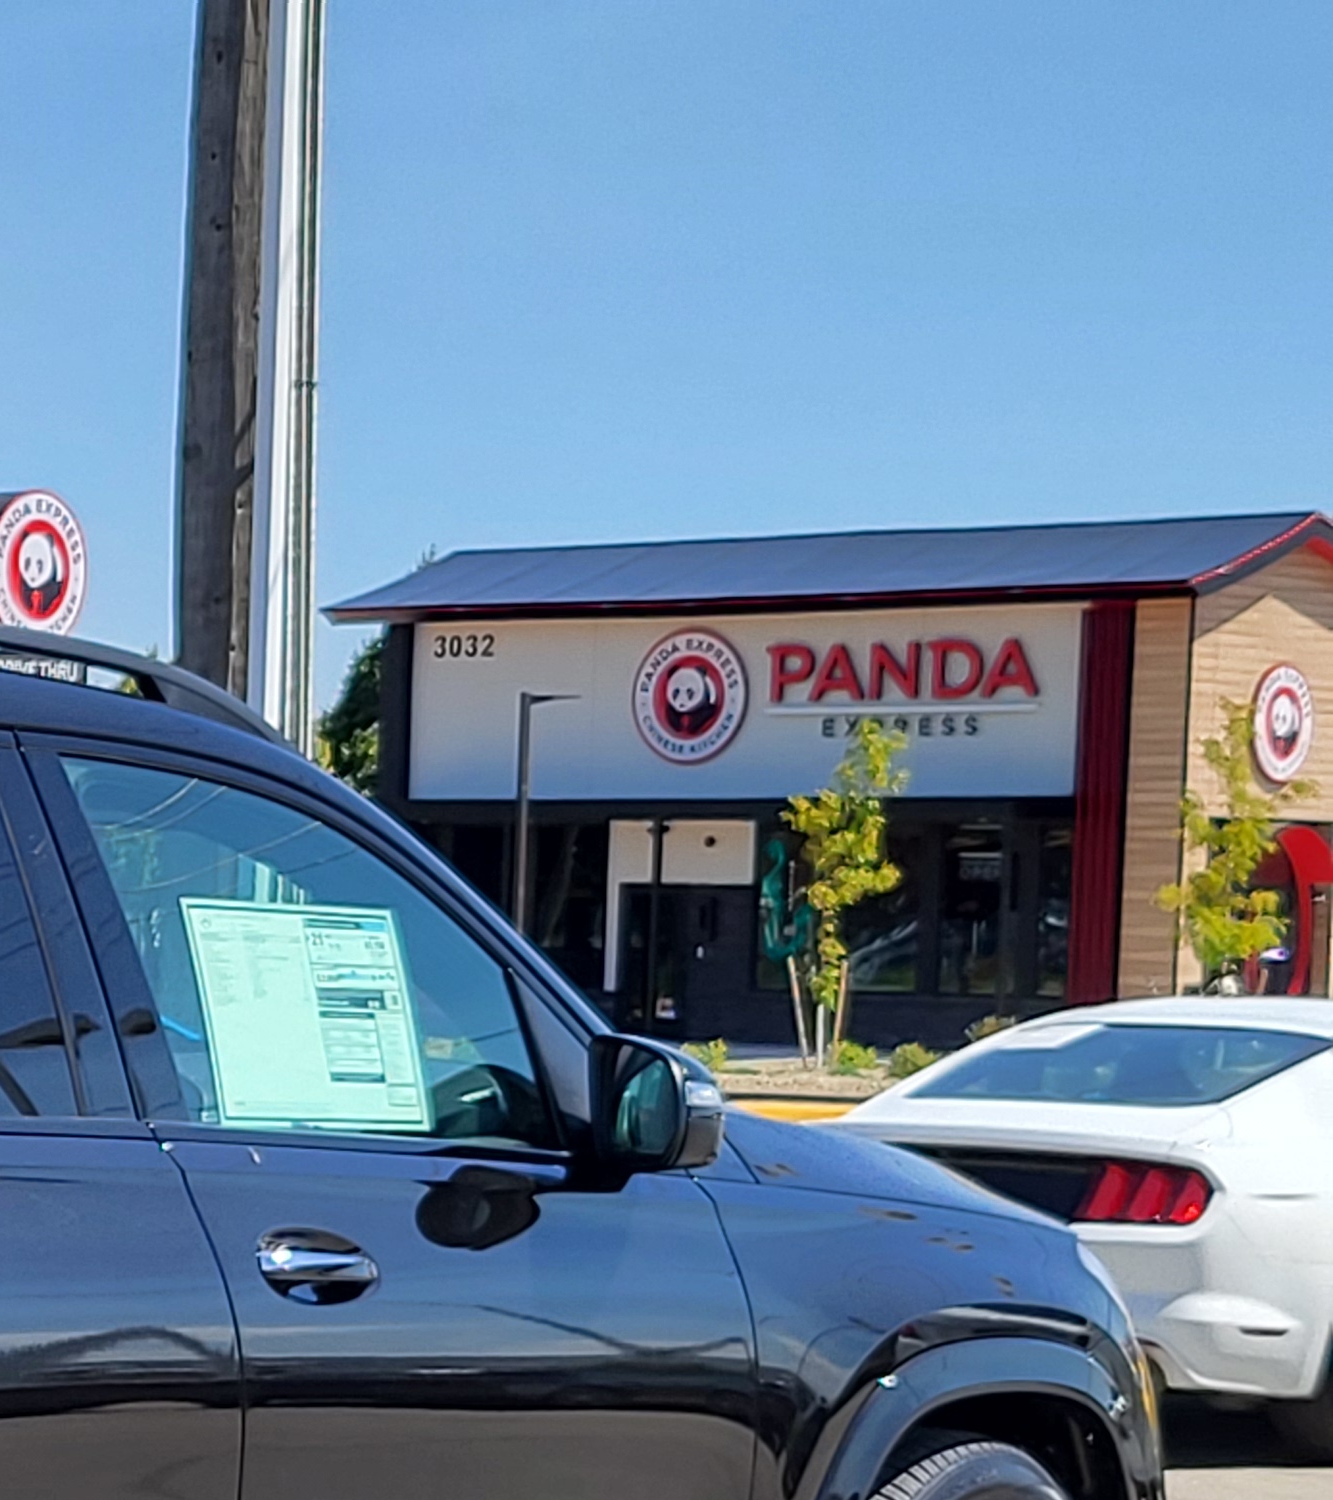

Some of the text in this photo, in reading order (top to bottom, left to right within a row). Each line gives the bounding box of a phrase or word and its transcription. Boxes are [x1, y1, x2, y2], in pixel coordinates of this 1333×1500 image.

[35, 498, 82, 566] EXPRESS
[433, 634, 495, 658] 3032
[640, 638, 739, 693] PANDA EXPRESS
[766, 637, 1040, 703] PANDA
